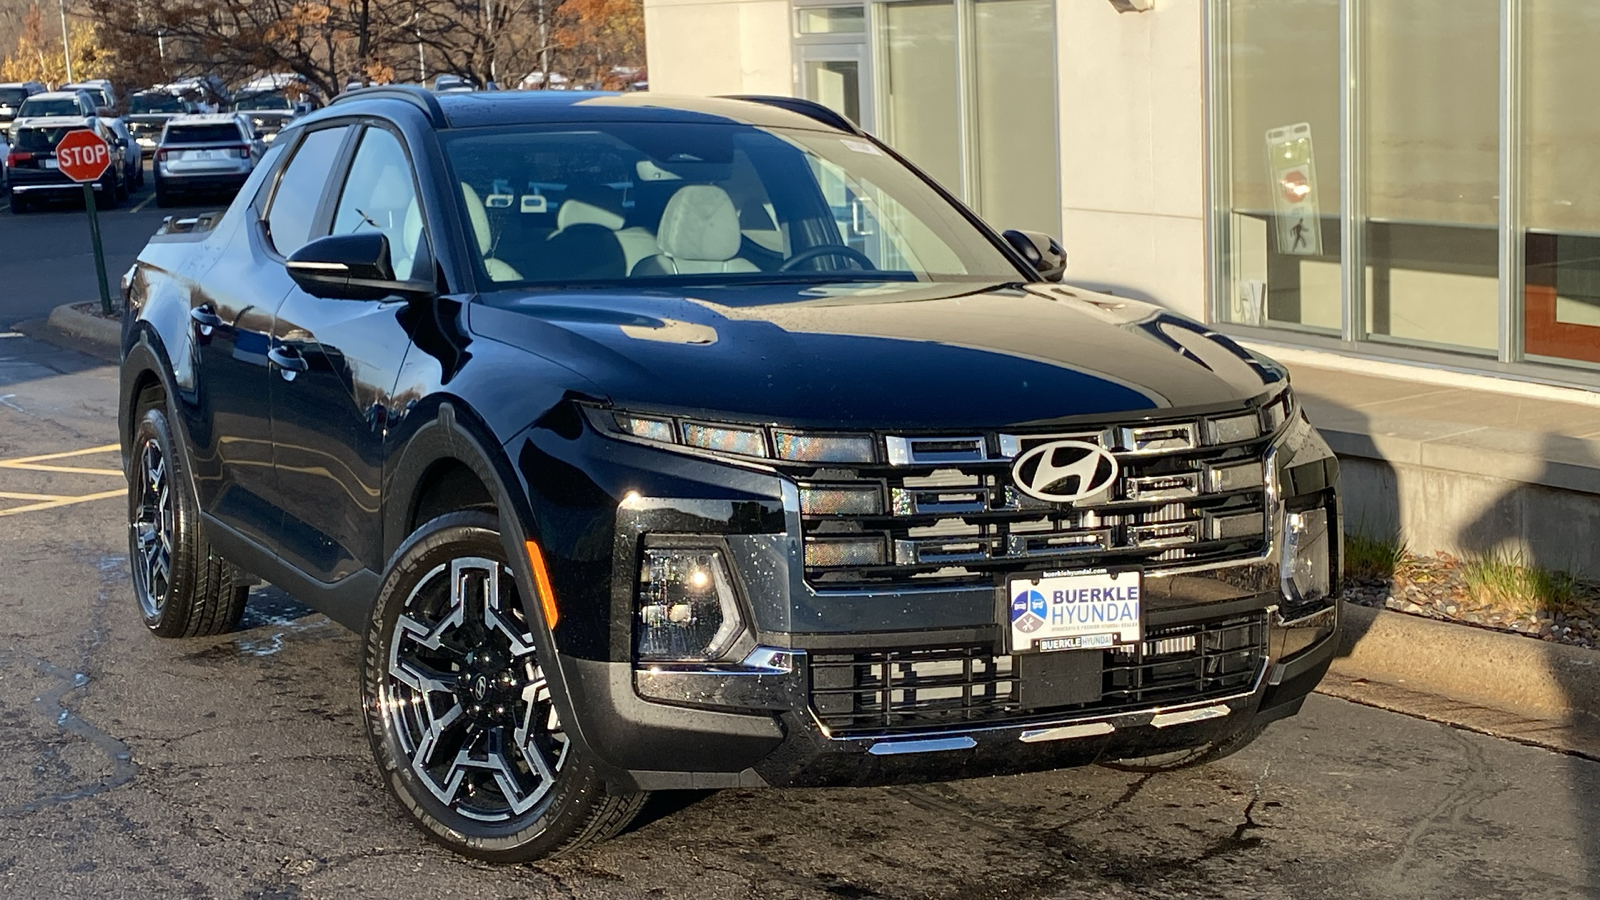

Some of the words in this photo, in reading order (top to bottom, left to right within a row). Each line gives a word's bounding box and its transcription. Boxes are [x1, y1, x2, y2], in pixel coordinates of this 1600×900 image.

[60, 144, 106, 167] STOP
[1043, 568, 1107, 577] buerklehyundai.com
[1053, 586, 1138, 604] BUERKLE
[1052, 602, 1138, 625] HYUNDAI
[1041, 638, 1081, 650] BUERKLE
[1082, 636, 1112, 646] HYUNDAI
[366, 628, 382, 735] MICHELIN
